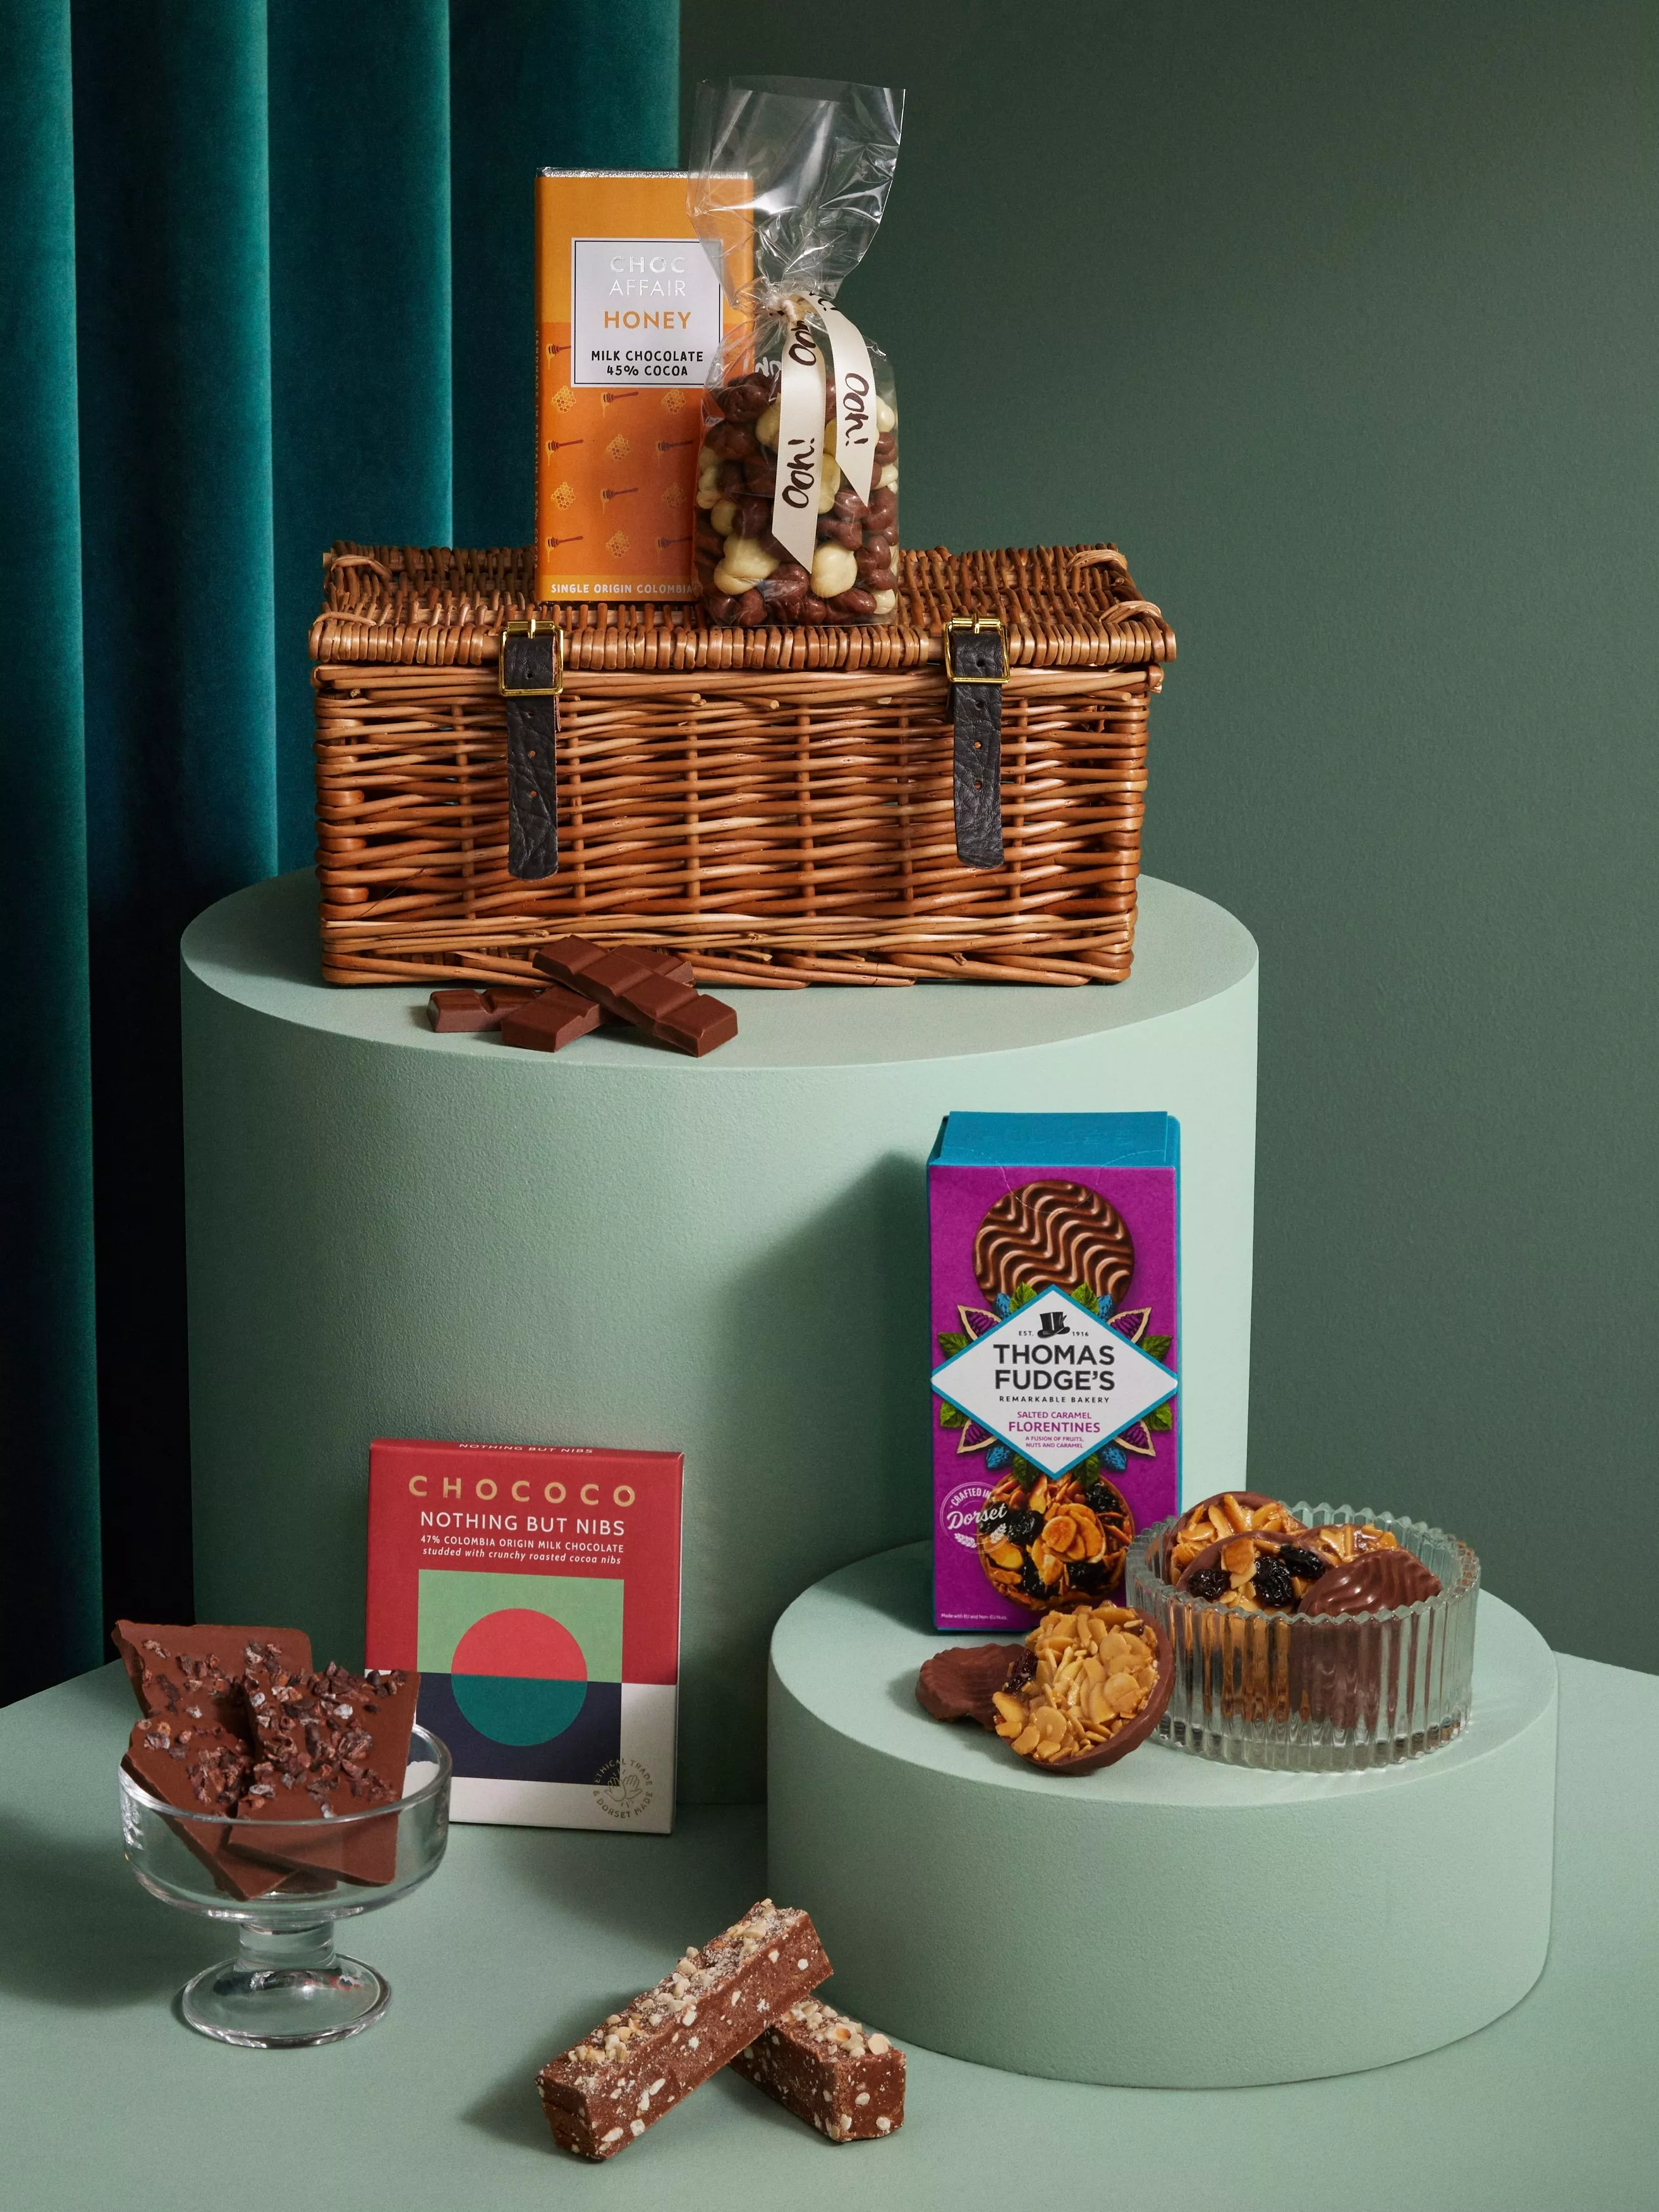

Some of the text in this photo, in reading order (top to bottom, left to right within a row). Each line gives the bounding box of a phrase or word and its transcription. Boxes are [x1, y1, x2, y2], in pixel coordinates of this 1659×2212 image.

[610, 256, 686, 273] CHOC
[609, 279, 686, 296] AFFAIR
[604, 311, 691, 329] HONEY
[592, 351, 703, 362] MILK CHOCOLATE
[607, 365, 688, 376] 45% COCOA
[842, 373, 869, 446] Ooh!
[782, 437, 815, 508] Ooh!
[550, 583, 693, 594] SINGLE ORIGIN COLOMBIA
[993, 1344, 1115, 1365] THOMAS
[995, 1370, 1115, 1391] FUDGE'S
[1009, 1421, 1100, 1433] FLORENTINES
[409, 1476, 635, 1507] CHOCOCO
[951, 1487, 982, 1507] CRAFTED
[420, 1511, 624, 1536] NOTHING BUT NIBS
[947, 1503, 1007, 1530] Dorset
[420, 1535, 624, 1553] 47% COLOMBIA ORIGIN MILK CHOCOLATE
[423, 1547, 621, 1564] studded with crunchy roasted cocoa nibs
[594, 1758, 653, 1786] ETHICAL TRADE
[597, 1798, 631, 1818] DORSET
[633, 1792, 653, 1815] MADE
